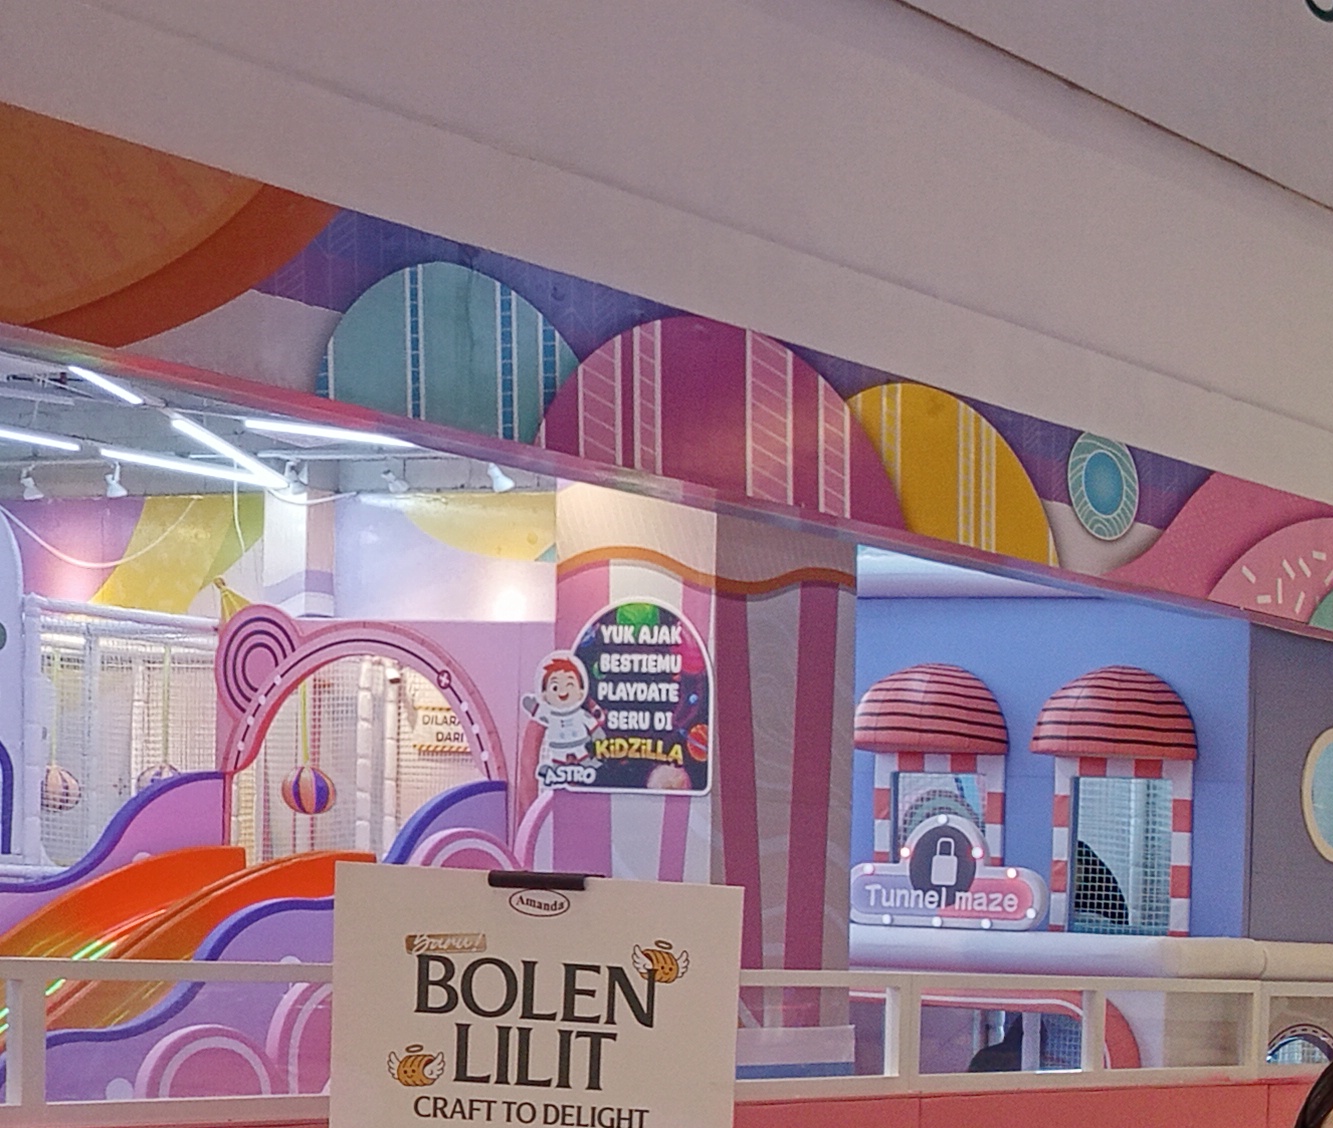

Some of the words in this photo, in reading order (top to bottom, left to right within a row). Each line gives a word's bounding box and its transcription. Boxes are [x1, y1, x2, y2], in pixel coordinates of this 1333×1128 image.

[600, 624, 635, 645] YUK
[638, 624, 682, 645] AJAK
[600, 653, 682, 674] BESTIEMU
[598, 682, 680, 703] PLAYDATE
[607, 711, 650, 731] SERU
[653, 711, 674, 731] DI
[545, 766, 597, 785] ASTRO
[515, 895, 565, 911] Amanda
[864, 883, 946, 909] Tunnel
[954, 891, 1019, 912] maze
[414, 954, 656, 1028] BOLEN
[453, 1023, 617, 1091] LILIT
[413, 1096, 497, 1122] CRAFT
[502, 1100, 537, 1125] TO
